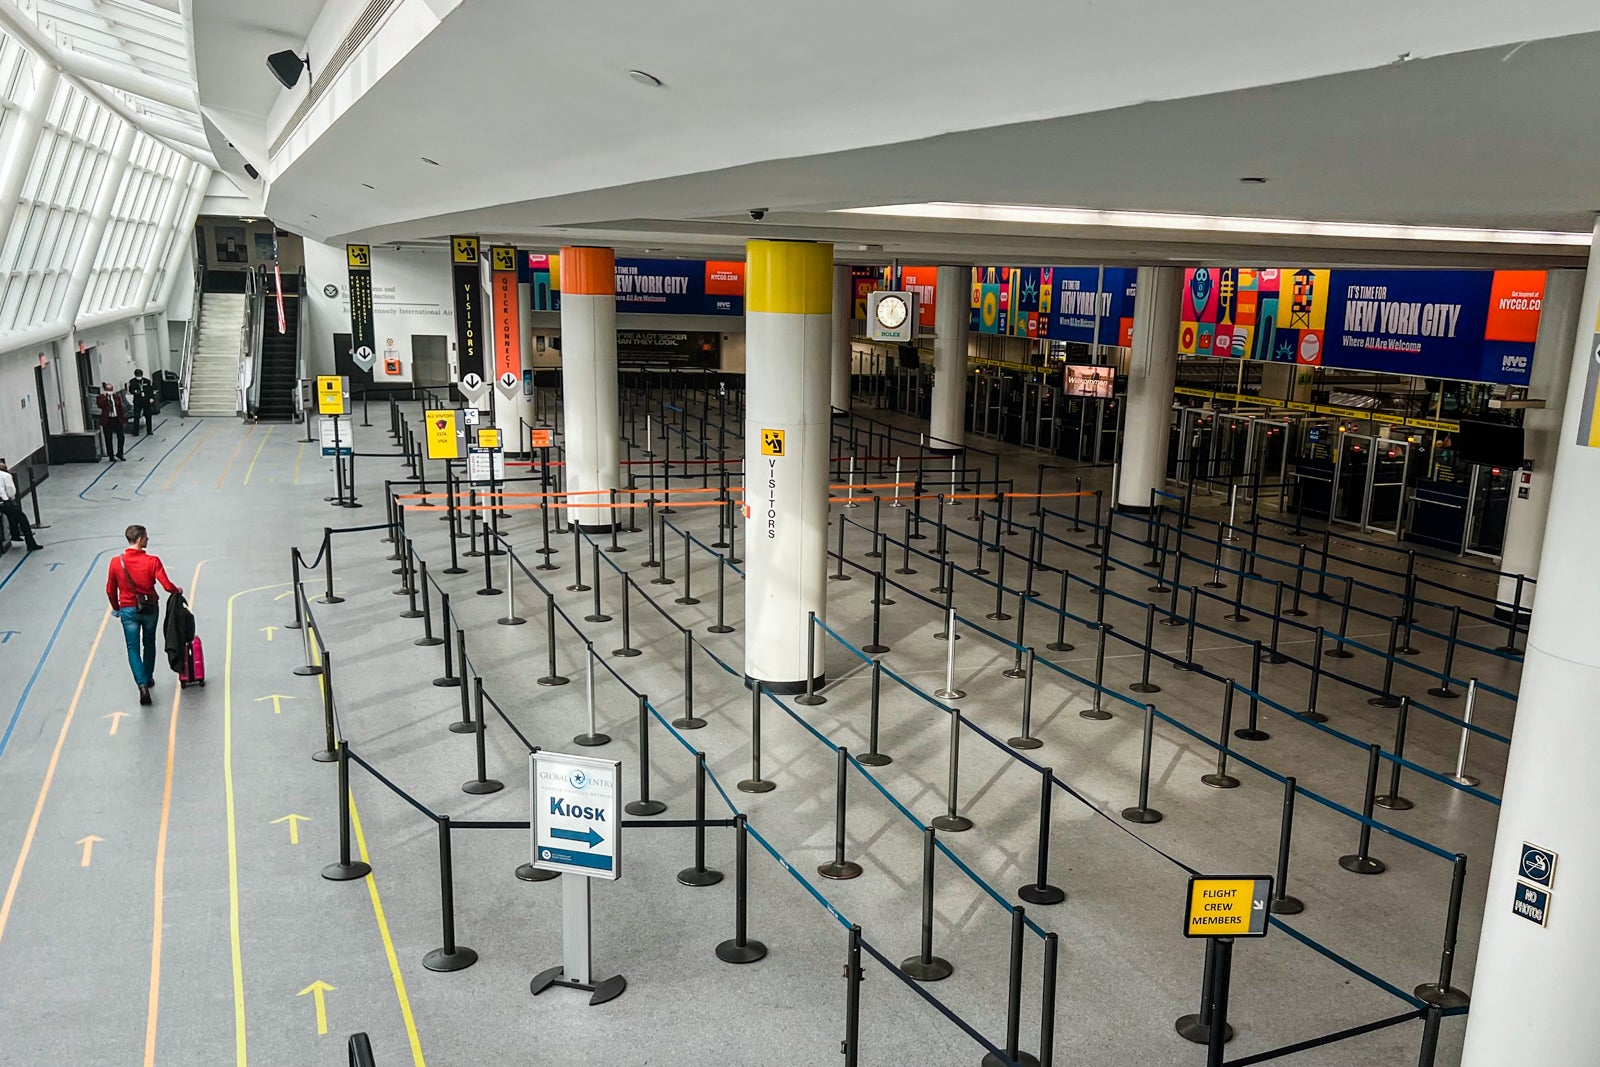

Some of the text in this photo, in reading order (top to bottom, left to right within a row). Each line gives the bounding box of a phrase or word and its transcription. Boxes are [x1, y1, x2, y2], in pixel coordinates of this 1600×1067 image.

[615, 275, 688, 294] EW YORK CITY
[1347, 286, 1387, 300] IT'S TIME FOR
[1060, 290, 1112, 317] NEW YORK CTY
[1499, 298, 1542, 310] NYCGO.CO
[464, 284, 474, 356] VISITORS
[1344, 300, 1461, 338] NEW YORK CITY
[1342, 336, 1422, 352] Where All Are Welcome
[1502, 355, 1527, 368] NYC
[1068, 377, 1108, 385] Willkommen
[768, 459, 776, 539] VISITORS
[540, 771, 613, 788] GLOBAL ENTRY
[1203, 890, 1237, 898] FLIGHT
[1524, 888, 1537, 904] NO
[1514, 900, 1542, 920] PHOTOS
[1192, 916, 1242, 925] MEMBERS
